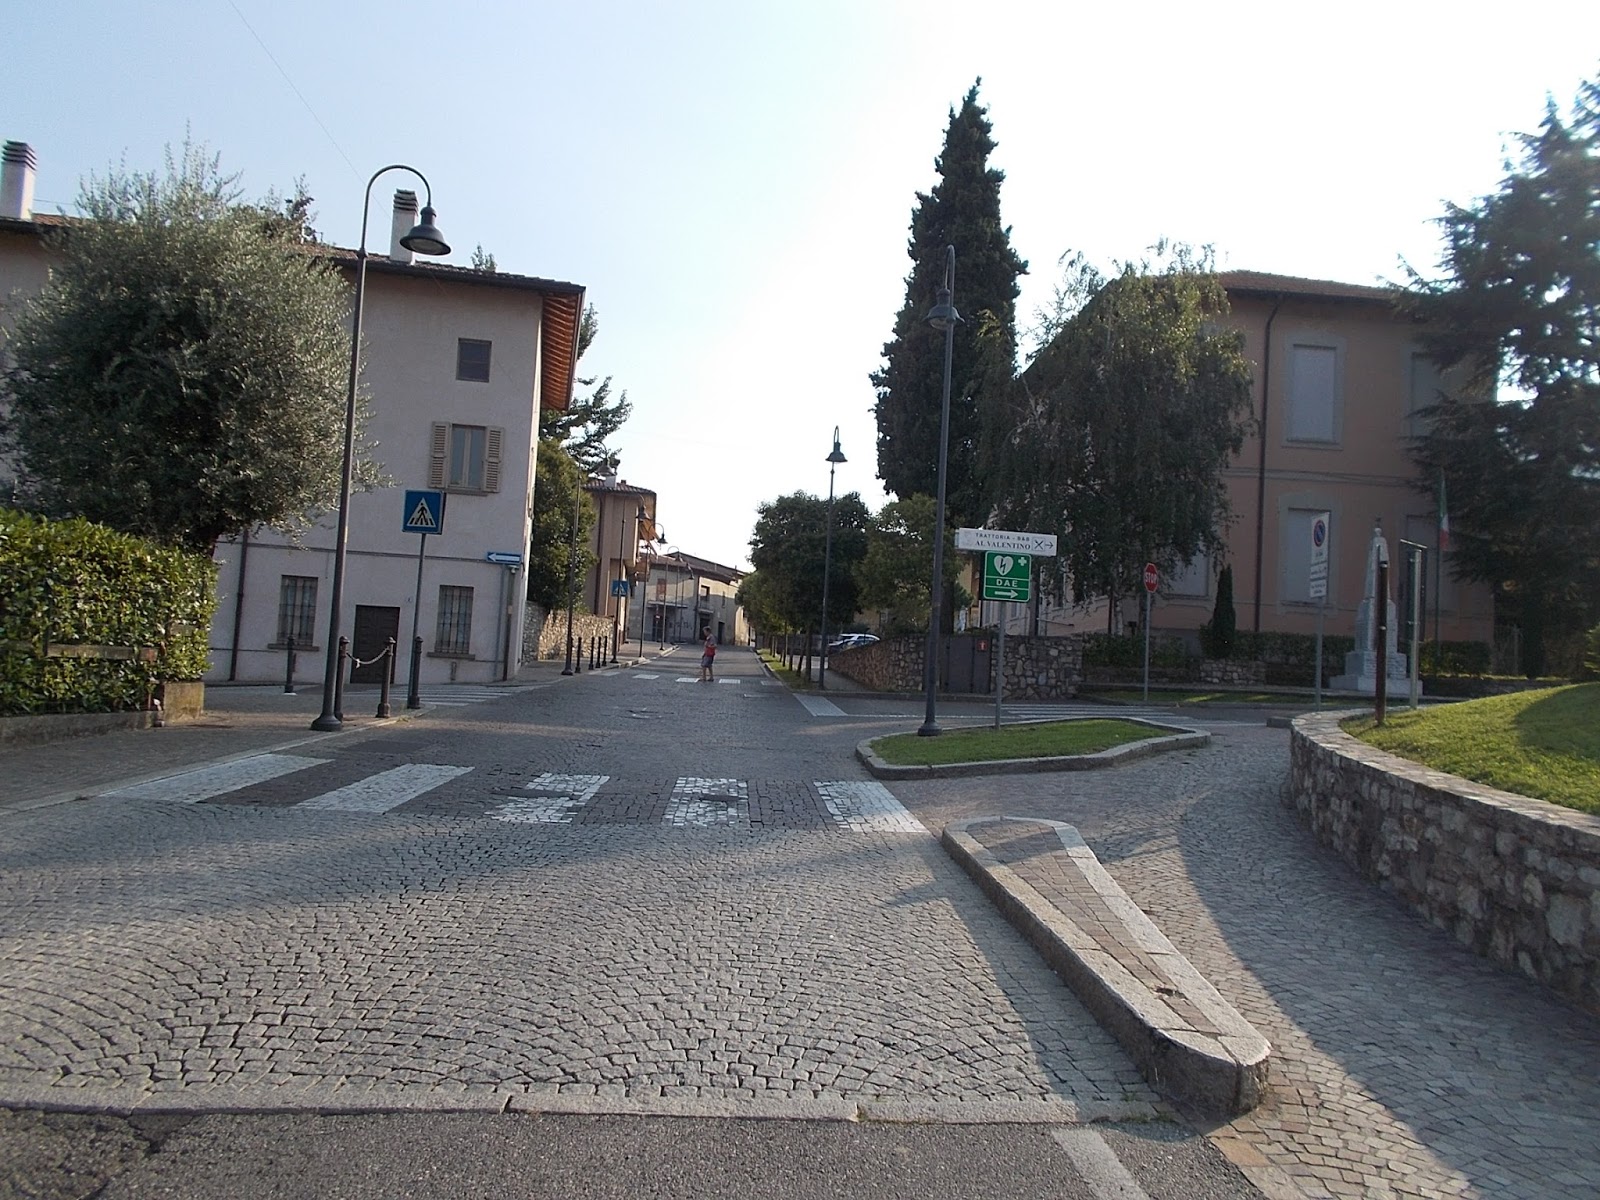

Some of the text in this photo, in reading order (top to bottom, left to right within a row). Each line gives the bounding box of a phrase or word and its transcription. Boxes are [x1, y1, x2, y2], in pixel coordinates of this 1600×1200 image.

[975, 532, 1010, 540] TRATTORIA
[987, 541, 1031, 550] VALENTINO
[1145, 571, 1157, 585] STOP
[996, 579, 1018, 588] DAE
